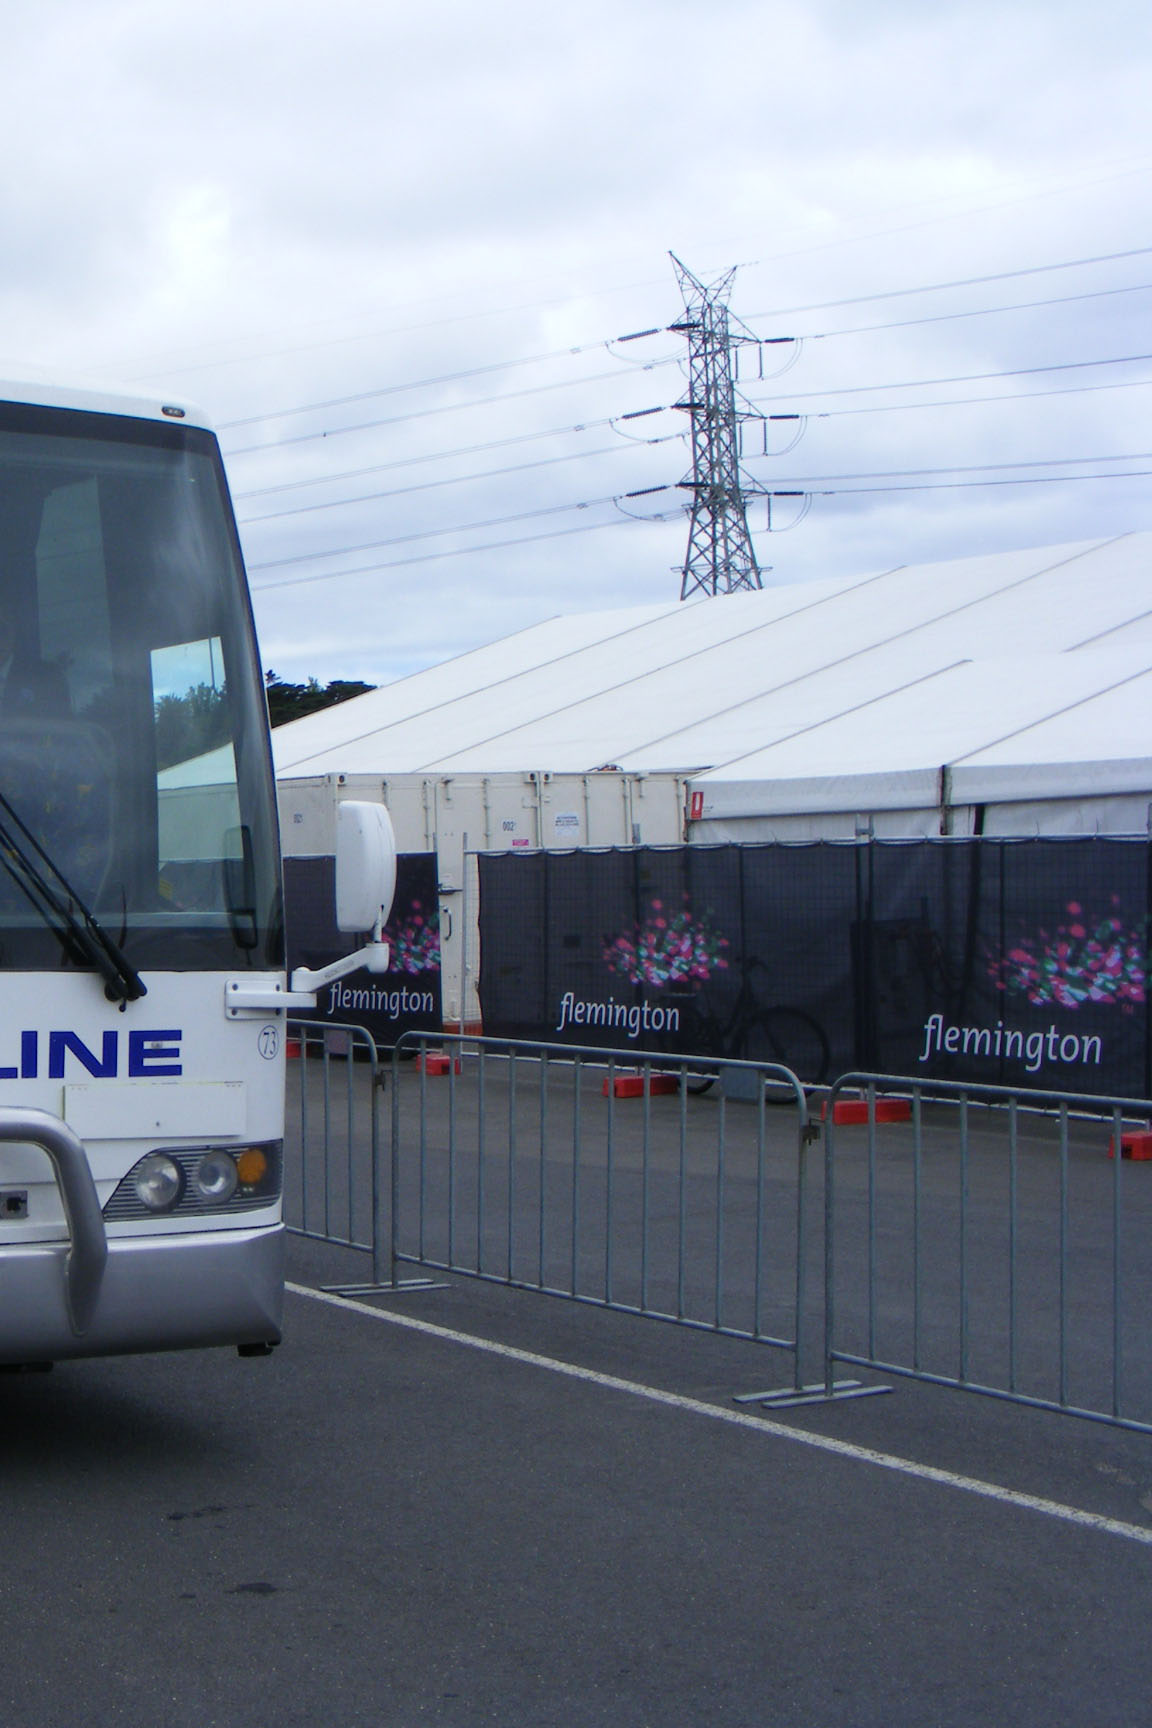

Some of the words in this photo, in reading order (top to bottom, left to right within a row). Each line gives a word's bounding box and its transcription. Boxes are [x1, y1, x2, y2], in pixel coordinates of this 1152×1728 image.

[328, 981, 434, 1020] flemington
[555, 992, 680, 1038] flemington
[262, 1031, 277, 1055] 73
[918, 1013, 1103, 1073] flemington
